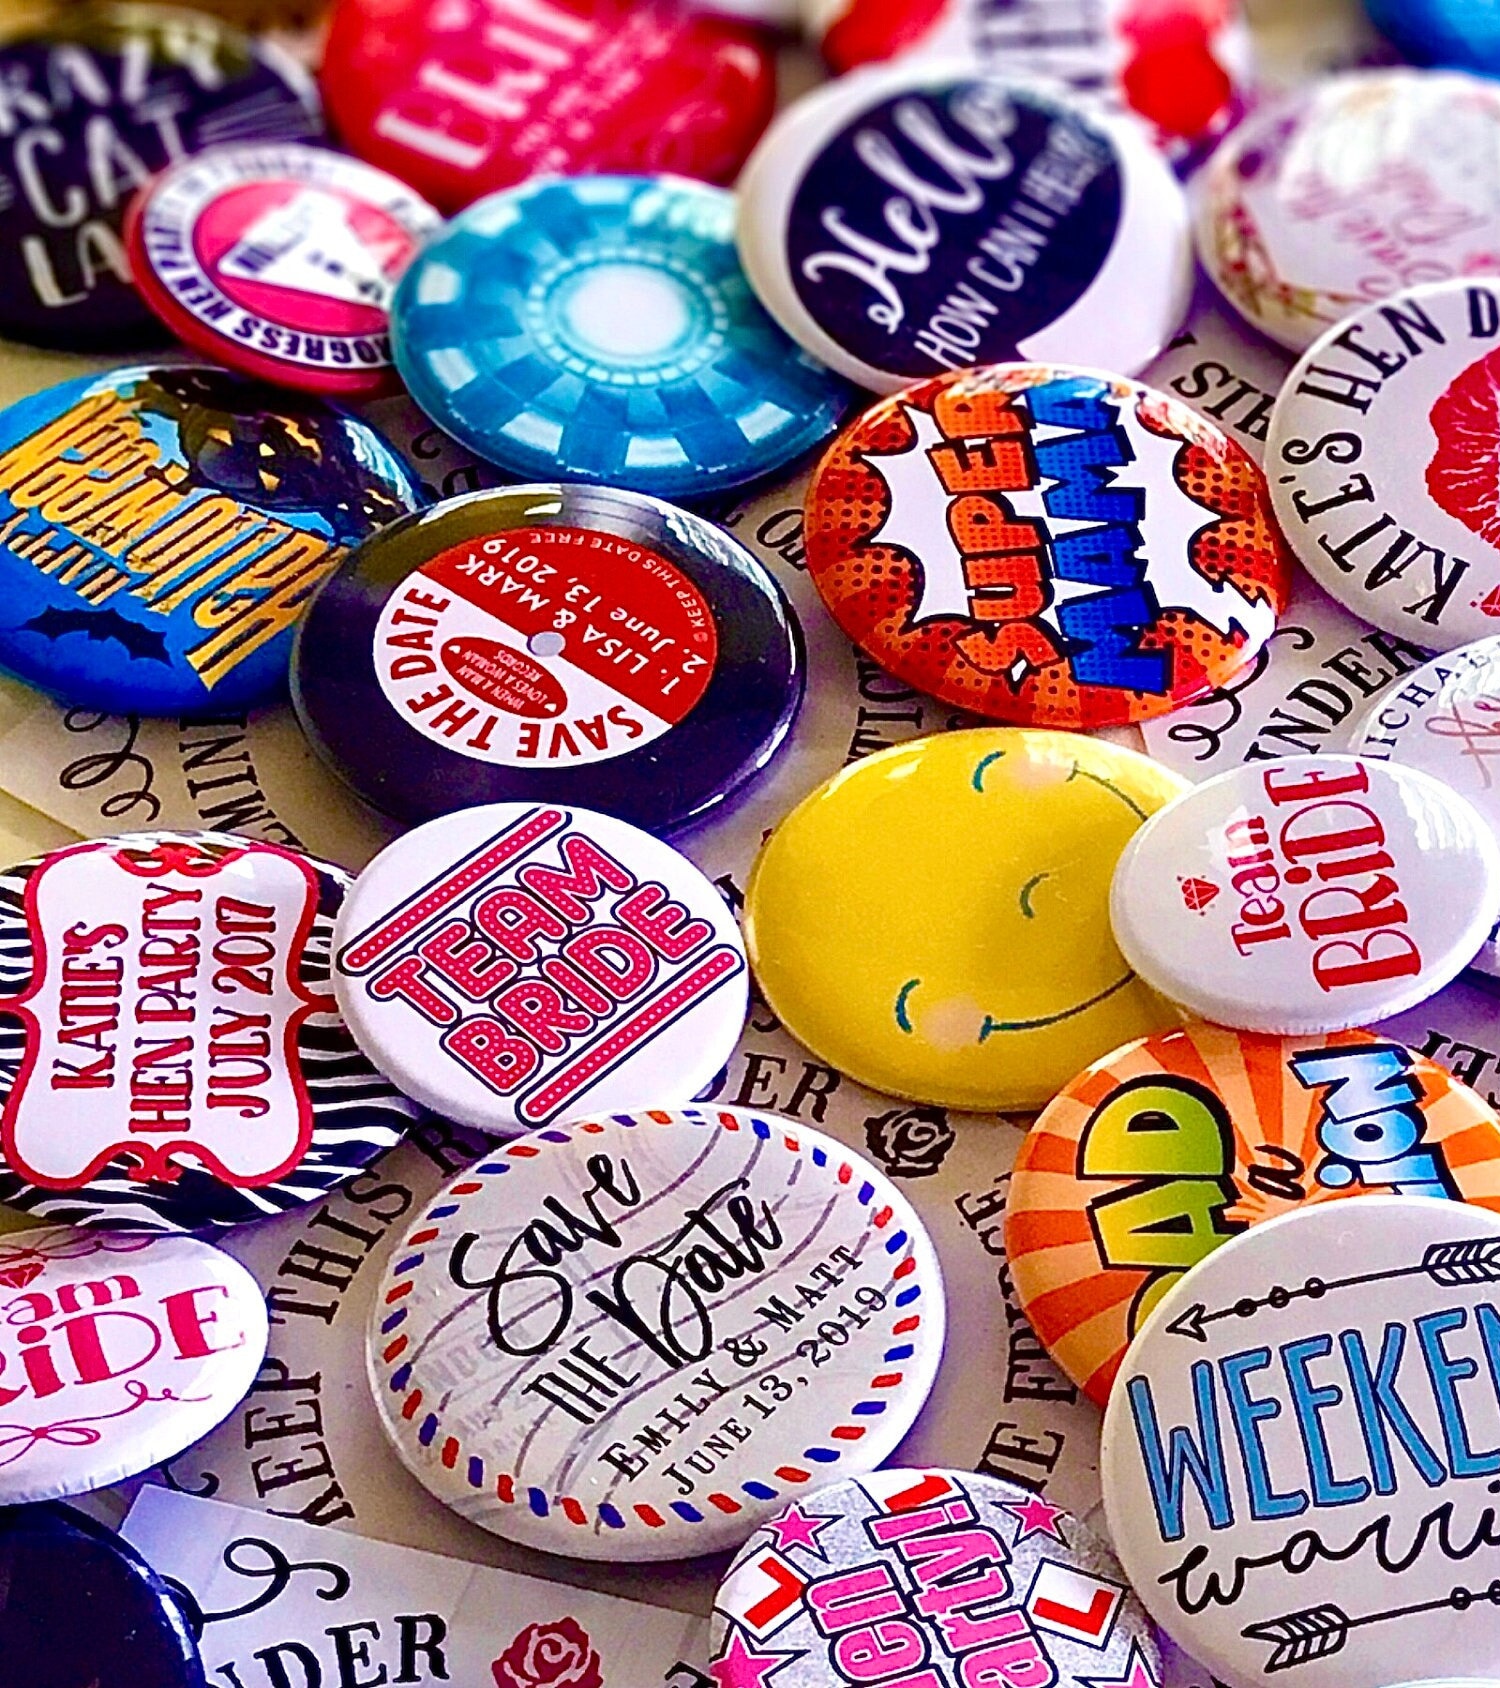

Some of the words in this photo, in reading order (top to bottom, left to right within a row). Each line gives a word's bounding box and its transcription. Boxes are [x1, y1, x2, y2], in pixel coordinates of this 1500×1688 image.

[0, 22, 222, 138] RAZY
[15, 97, 197, 228] CAT
[802, 85, 1019, 334] Hello
[21, 222, 134, 308] LA
[914, 282, 1000, 369] HOW
[968, 215, 1050, 292] CAN
[1016, 198, 1056, 229] I
[234, 316, 394, 365] ROGRESS
[1297, 299, 1446, 415] HEN
[455, 553, 549, 609] MARK
[481, 537, 557, 583] 2019
[591, 536, 640, 562] DATE
[640, 557, 679, 588] THIS
[928, 385, 1065, 685] SUPER
[1025, 380, 1174, 695] MAMA
[1279, 430, 1470, 625] KATE'S
[386, 588, 451, 682] DATE
[552, 606, 575, 628] &
[565, 576, 601, 611] 13,
[584, 622, 649, 673] LISA
[608, 605, 674, 653] June
[675, 586, 705, 627] KEEP
[406, 685, 499, 751] THE
[517, 704, 645, 761] SAVE
[366, 831, 637, 1029] TEAM
[1223, 815, 1292, 957] Team
[135, 882, 203, 1024] PARTY
[212, 896, 277, 995] 2017
[439, 880, 716, 1096] BRIDE
[50, 922, 131, 1091] KATIE'S
[206, 1006, 272, 1120] JULY
[129, 1033, 194, 1134] HEN
[0, 1275, 141, 1327] am
[268, 1170, 412, 1326] THIS
[448, 1151, 641, 1357] Save
[521, 1336, 640, 1425] THE
[586, 1177, 784, 1370] Date
[599, 1371, 732, 1481] EMILY
[724, 1328, 770, 1368] &
[757, 1244, 865, 1333] MATT
[662, 1417, 753, 1498] JUNE
[755, 1372, 811, 1421] 13,
[797, 1285, 889, 1369] 2019
